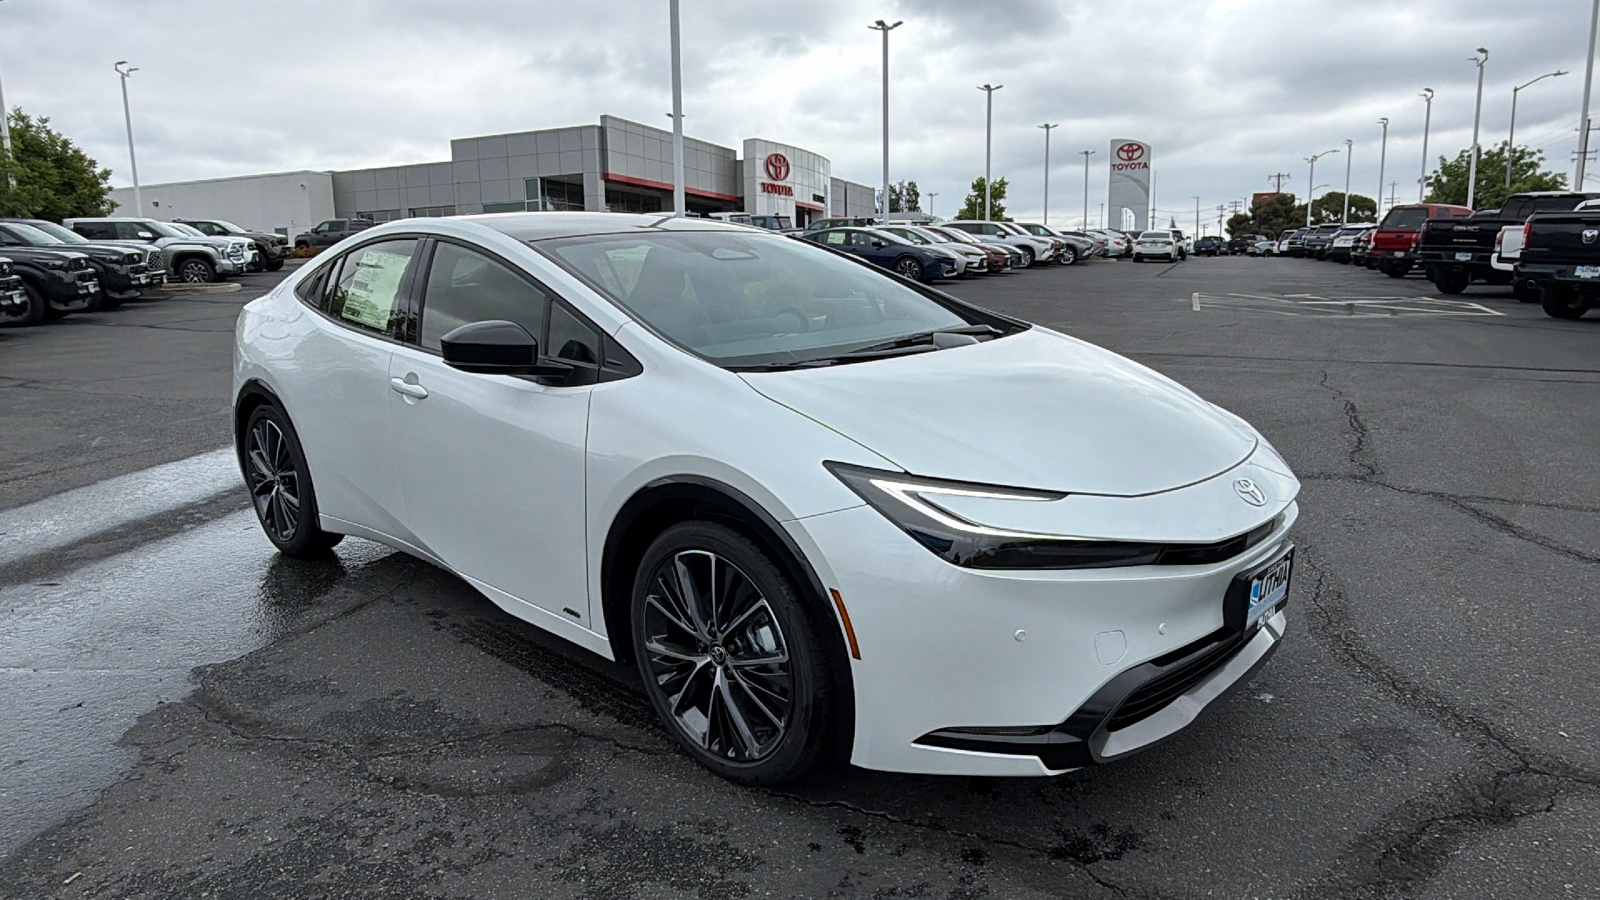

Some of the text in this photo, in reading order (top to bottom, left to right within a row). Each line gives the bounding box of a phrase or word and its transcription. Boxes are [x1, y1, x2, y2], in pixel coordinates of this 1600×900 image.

[1111, 162, 1148, 171] TOYOTA
[761, 182, 793, 196] TOYOTA
[1258, 560, 1289, 602] LITHIA
